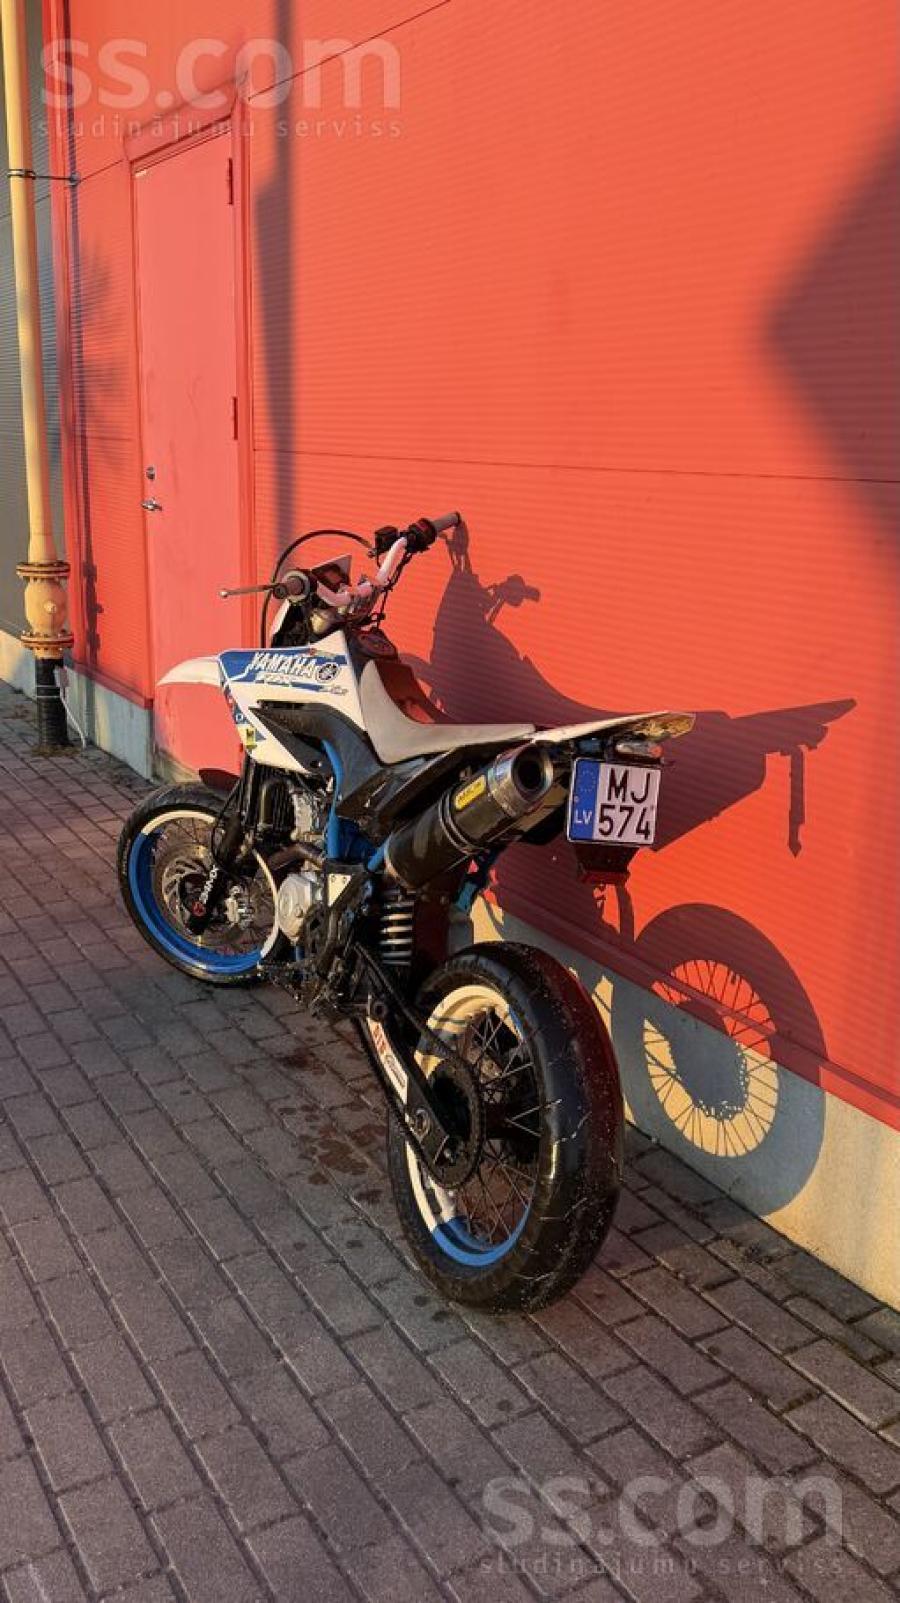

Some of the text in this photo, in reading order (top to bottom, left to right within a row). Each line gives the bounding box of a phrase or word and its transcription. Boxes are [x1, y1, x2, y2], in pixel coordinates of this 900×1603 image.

[251, 652, 317, 677] YAMAHA
[607, 768, 650, 803] MJ
[573, 810, 592, 825] LV
[598, 804, 650, 839] 574
